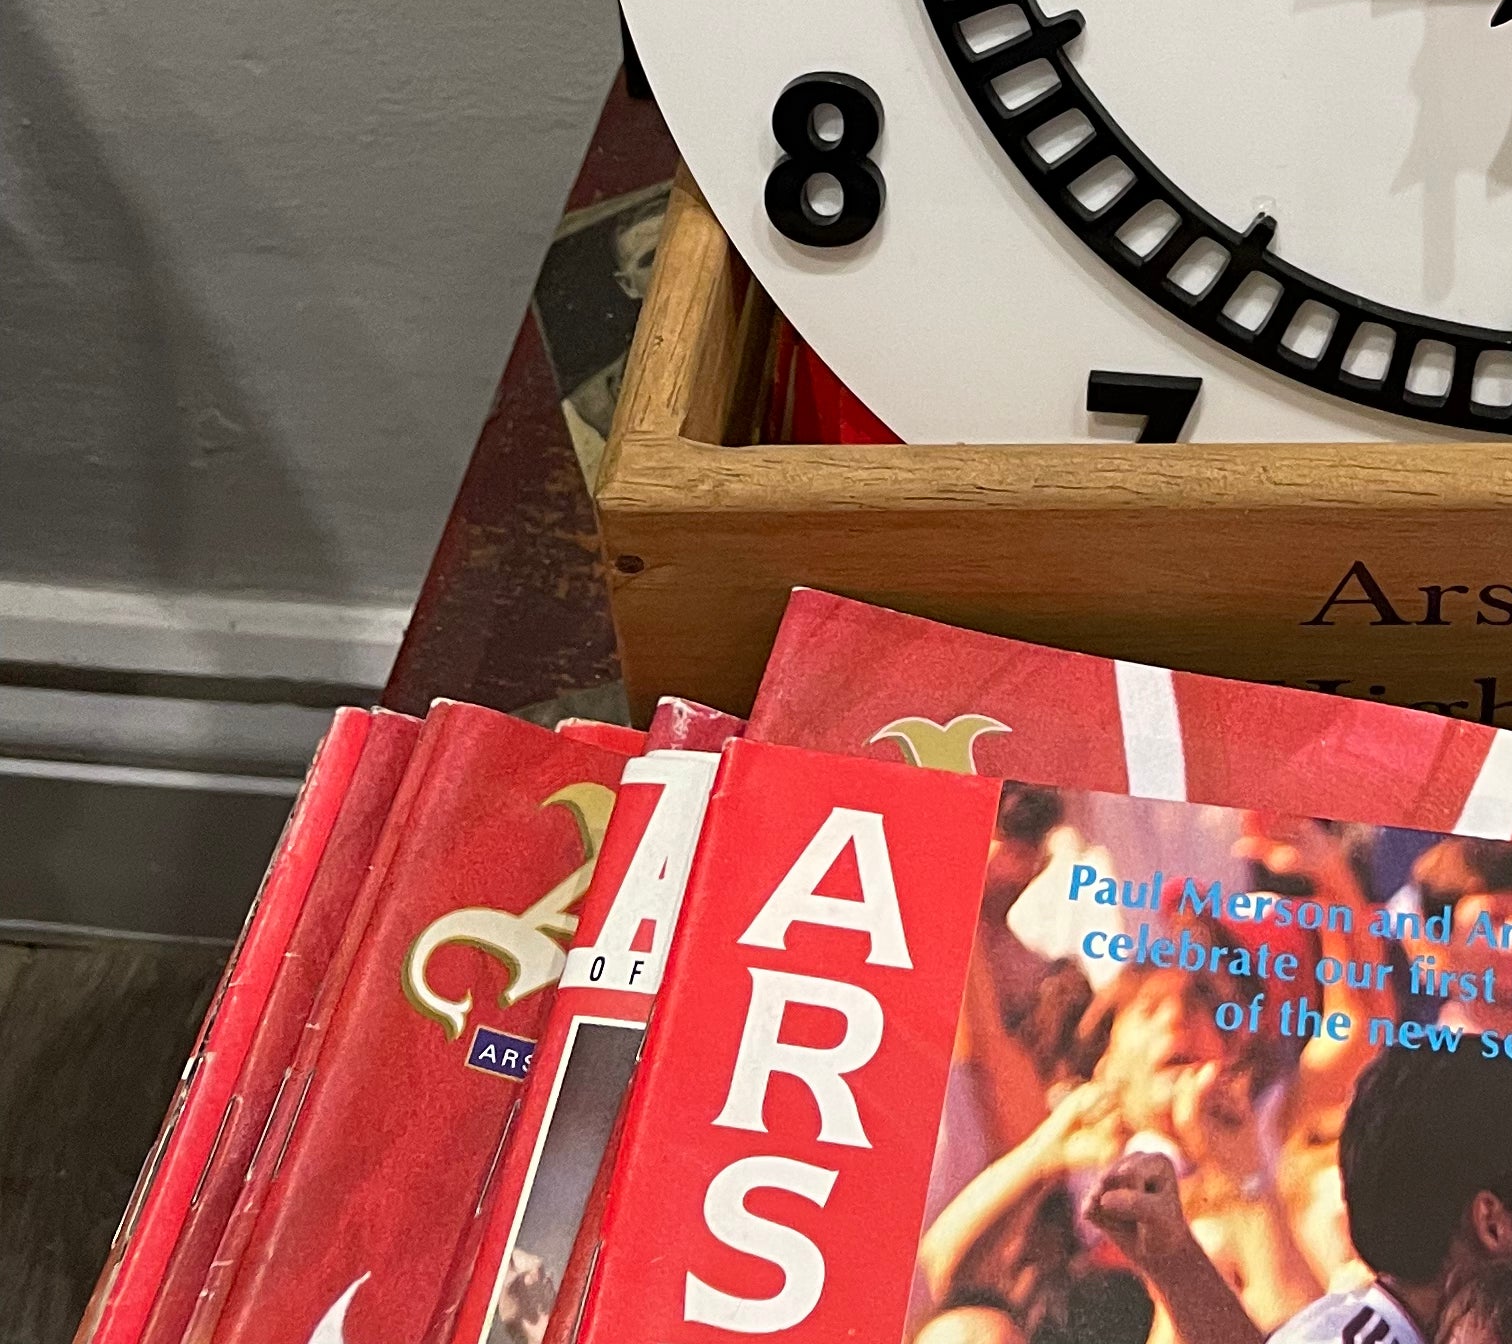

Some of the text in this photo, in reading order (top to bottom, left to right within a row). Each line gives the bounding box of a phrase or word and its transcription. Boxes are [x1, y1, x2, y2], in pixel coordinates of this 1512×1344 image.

[764, 70, 886, 248] 8
[1068, 863, 1162, 912] Paul
[1177, 880, 1353, 933] Merson
[1368, 904, 1452, 945] and
[1082, 929, 1298, 982] celebrate
[1315, 955, 1394, 991] our
[1409, 954, 1494, 1003] first
[1214, 992, 1266, 1033] of
[1280, 997, 1351, 1041] the
[1368, 1018, 1464, 1053] new
